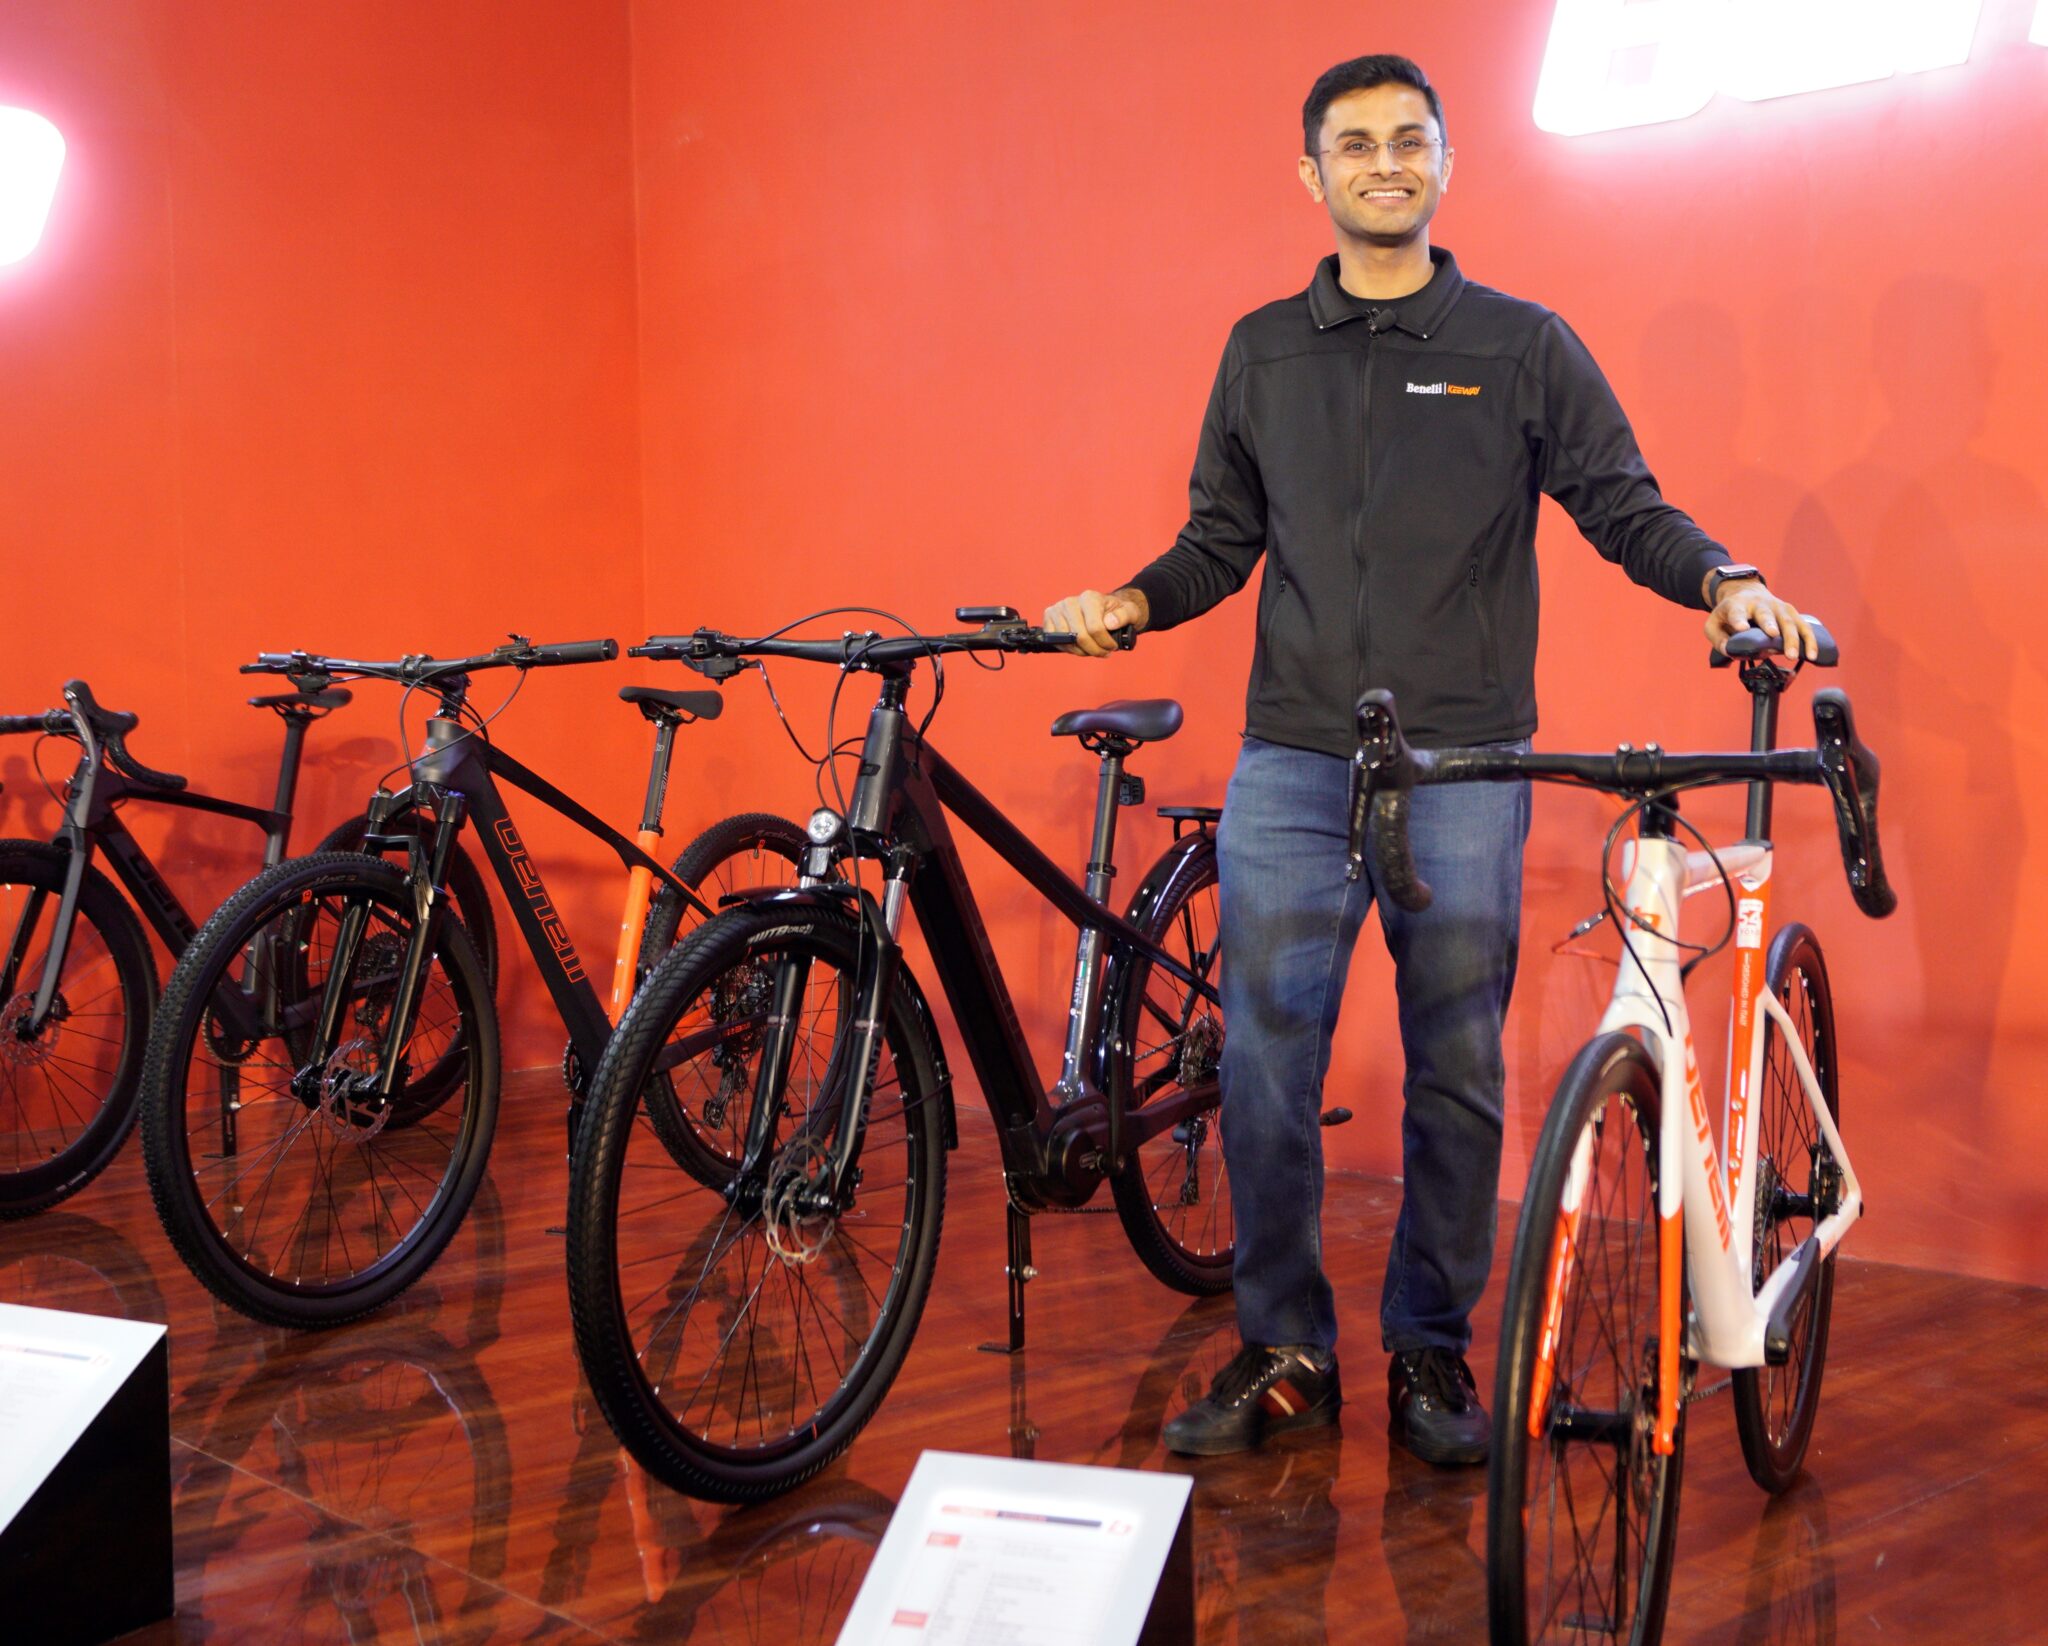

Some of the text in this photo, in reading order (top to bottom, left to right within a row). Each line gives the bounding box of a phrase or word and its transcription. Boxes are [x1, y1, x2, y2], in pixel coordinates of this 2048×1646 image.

[1406, 382, 1481, 396] Benelli KEEWAY
[494, 816, 588, 984] benelli
